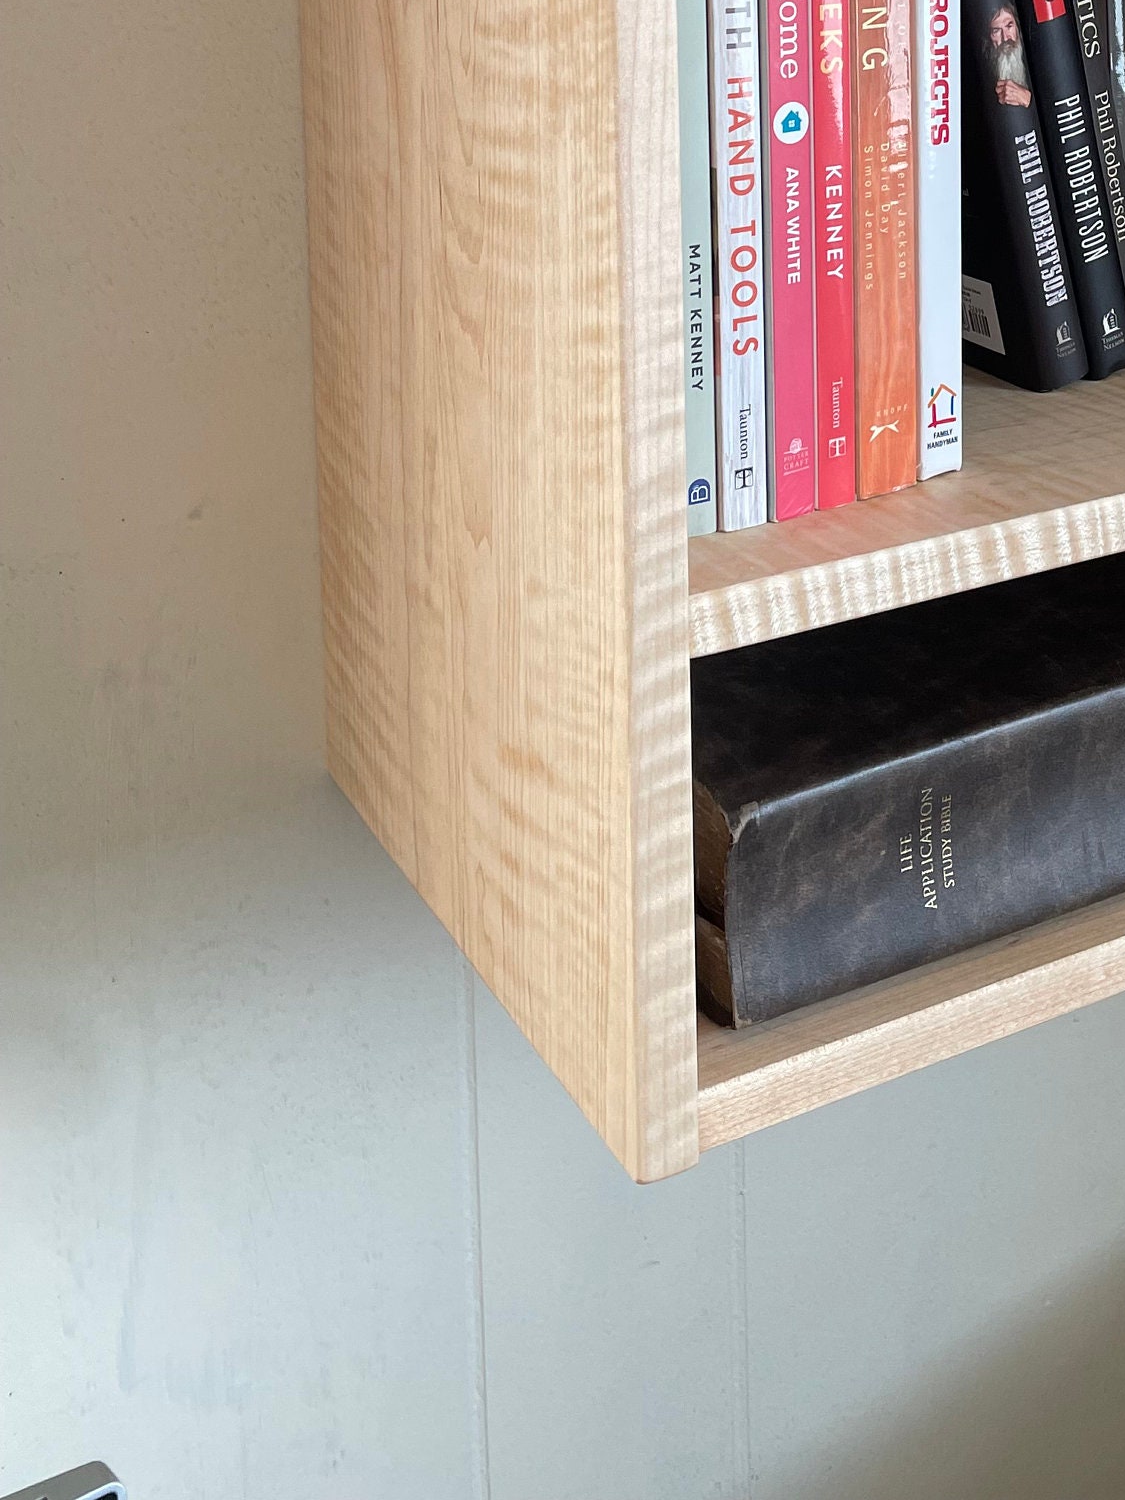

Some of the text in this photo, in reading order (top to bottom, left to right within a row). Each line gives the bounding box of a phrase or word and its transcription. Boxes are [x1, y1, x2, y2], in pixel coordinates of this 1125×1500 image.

[727, 76, 755, 196] HAND
[1095, 90, 1119, 137] Phil
[825, 165, 844, 280] KENNEY
[864, 145, 874, 290] Simon Jennings
[880, 142, 891, 233] David Day
[1015, 130, 1068, 307] PHIL ROBERTSON
[1054, 94, 1109, 263] PHIL ROBERTSON
[786, 167, 801, 285] ANA WHITE
[898, 210, 908, 279] Jackson
[688, 244, 704, 392] MATT KENNEY
[730, 220, 758, 357] TOOLS
[738, 404, 751, 460] Taunton
[831, 377, 843, 429] Taunton
[876, 403, 908, 418] KNOPF
[927, 436, 958, 450] HANDYMAN
[933, 429, 953, 439] FAMILY
[783, 459, 808, 471] CRAFT
[900, 833, 913, 873] LIFE
[920, 787, 937, 909] APPLICATION
[940, 794, 955, 888] STUDY BIBLE
